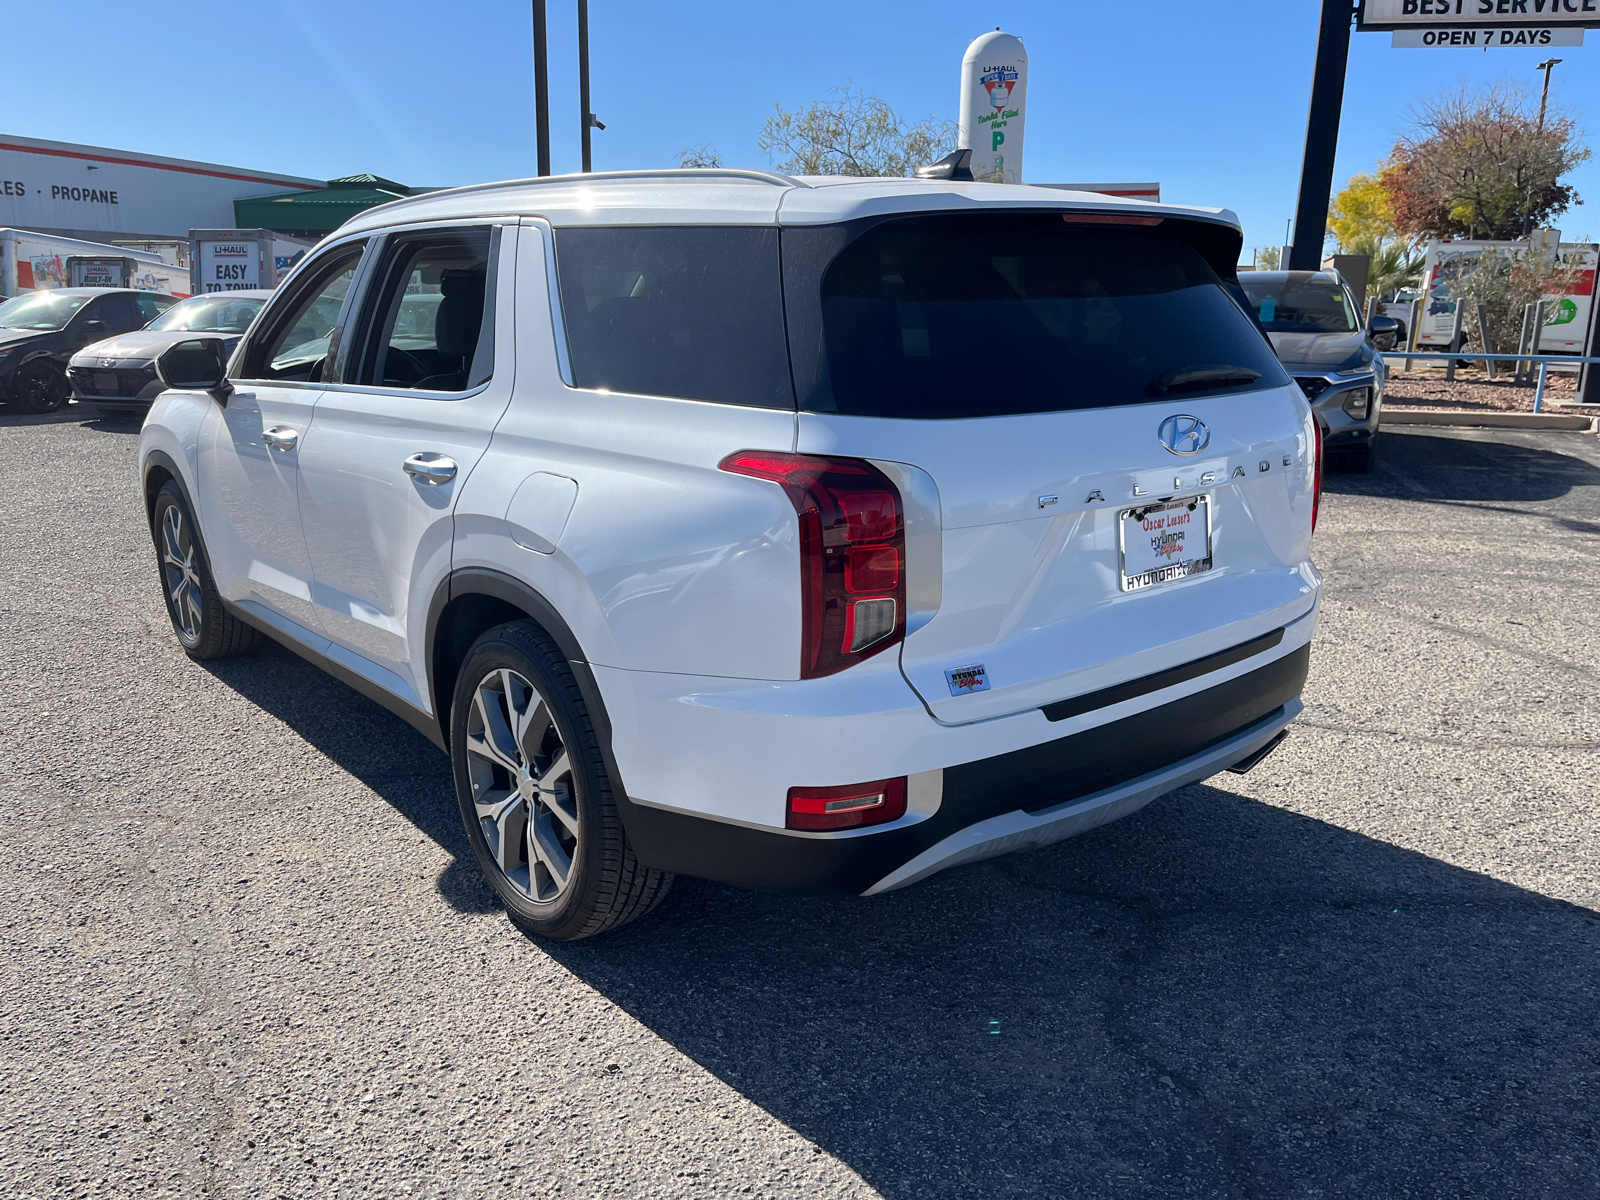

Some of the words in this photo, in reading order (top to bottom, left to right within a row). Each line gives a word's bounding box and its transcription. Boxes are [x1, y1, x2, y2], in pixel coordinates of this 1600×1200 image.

[1402, 0, 1462, 15] BEST
[1478, 0, 1596, 15] SERVICE
[1422, 31, 1476, 46] OPEN
[1483, 31, 1494, 45] 7
[1499, 30, 1552, 45] DAYS
[983, 65, 1016, 73] U-HAUL
[984, 73, 999, 82] OPEN
[977, 111, 998, 124] Tanks
[1001, 107, 1019, 120] Filled
[991, 120, 1007, 130] Here
[51, 185, 119, 204] PROPANE
[214, 246, 247, 254] U-HAUL
[215, 264, 247, 280] EASY
[1038, 455, 1292, 510] PALISADE
[1142, 517, 1165, 532] Oscar
[1167, 511, 1191, 528] Leeser's
[1150, 531, 1185, 547] HYUNDAI
[1127, 566, 1177, 590] HYUNDAI
[951, 668, 985, 681] HYUNDAI
